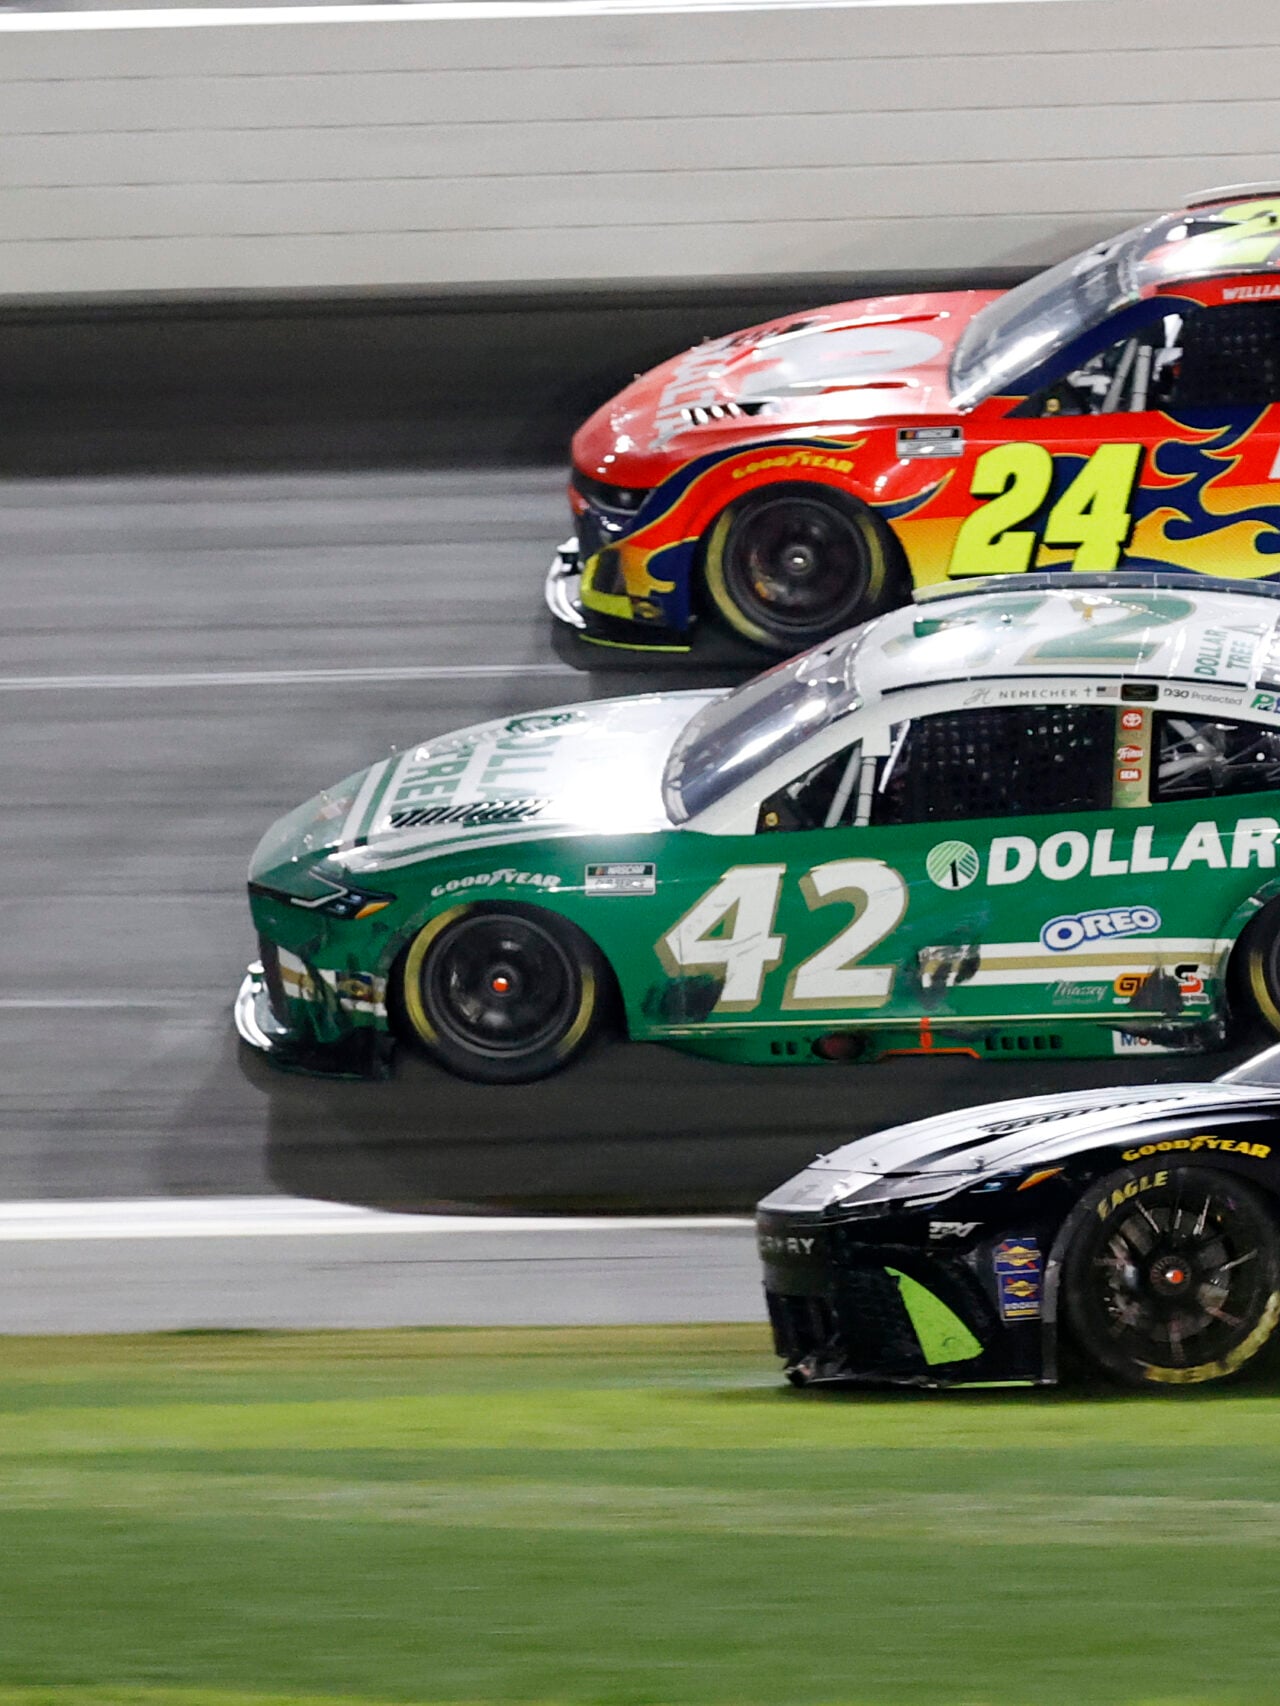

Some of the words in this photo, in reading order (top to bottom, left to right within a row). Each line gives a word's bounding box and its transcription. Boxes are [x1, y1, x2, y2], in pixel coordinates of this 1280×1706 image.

[732, 451, 854, 479] GOODYEAR
[949, 442, 1147, 577] 24
[1194, 629, 1228, 676] DOLLAR
[1226, 641, 1253, 670] TREE
[999, 688, 1078, 699] NEMECHEK
[986, 817, 1280, 886] DOLLAR
[431, 868, 562, 897] GOODYEAR
[653, 858, 910, 1014] 42
[1042, 907, 1159, 951] OREO
[1121, 1135, 1272, 1162] GOODYEAR
[1097, 1170, 1169, 1222] EAGLE
